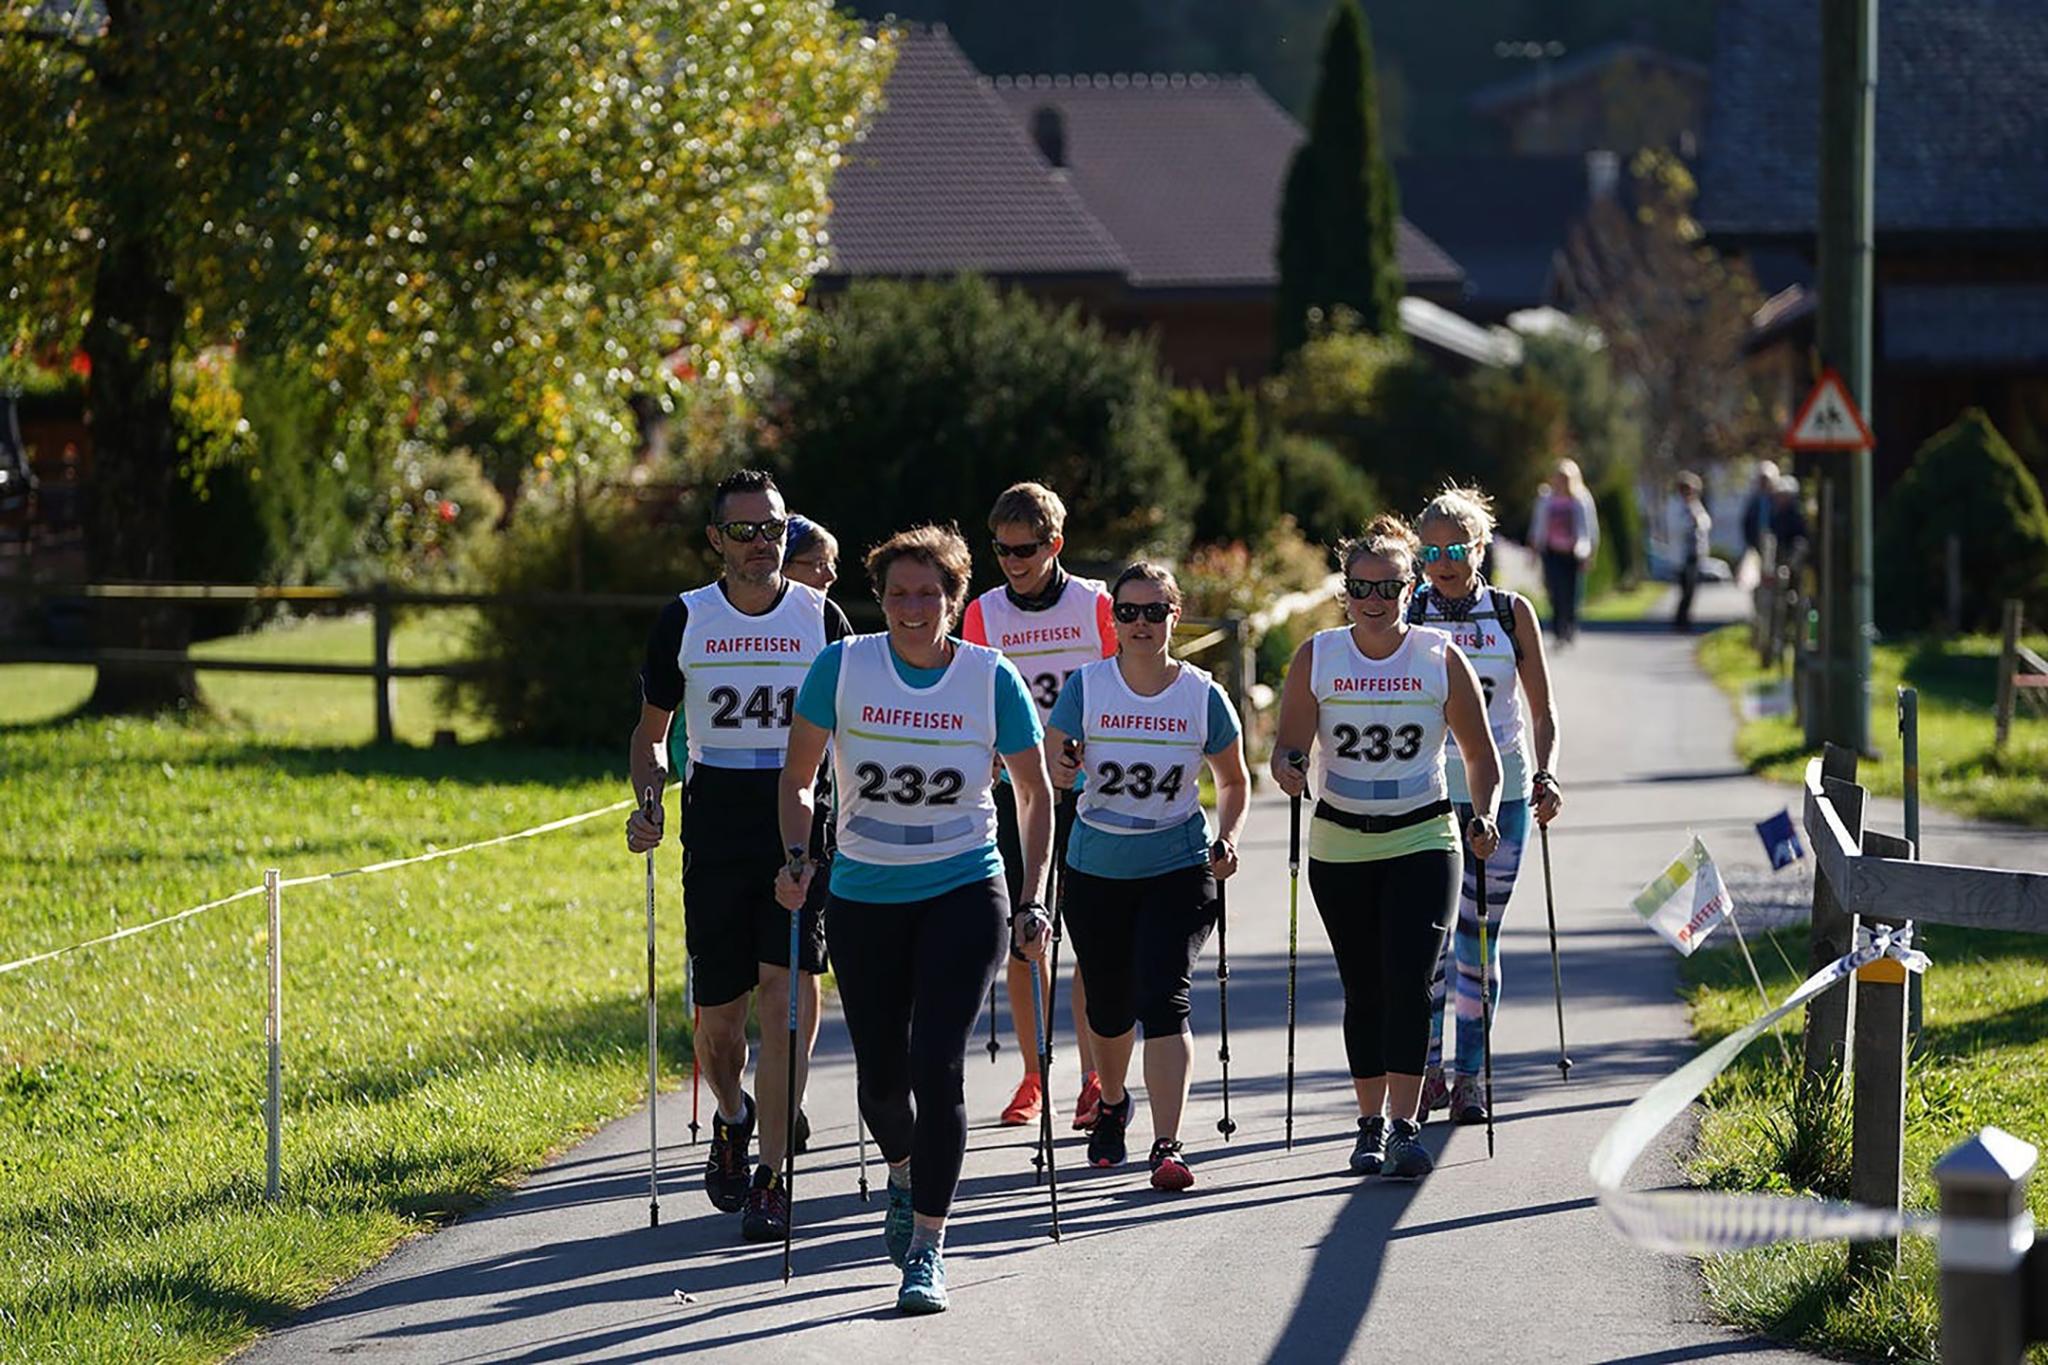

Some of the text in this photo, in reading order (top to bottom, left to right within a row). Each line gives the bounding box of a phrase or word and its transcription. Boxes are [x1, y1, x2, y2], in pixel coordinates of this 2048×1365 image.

[706, 638, 801, 653] RAIFFEISEN
[1002, 626, 1081, 647] RAIFFEISEN
[1333, 677, 1422, 692] RAIFFEISEN
[708, 685, 797, 729] 241
[862, 706, 963, 730] RAIFFEISEN
[1101, 714, 1188, 733] RAIFFEISEN
[1332, 723, 1425, 762] 233
[855, 760, 966, 807] 232
[1097, 761, 1185, 802] 234
